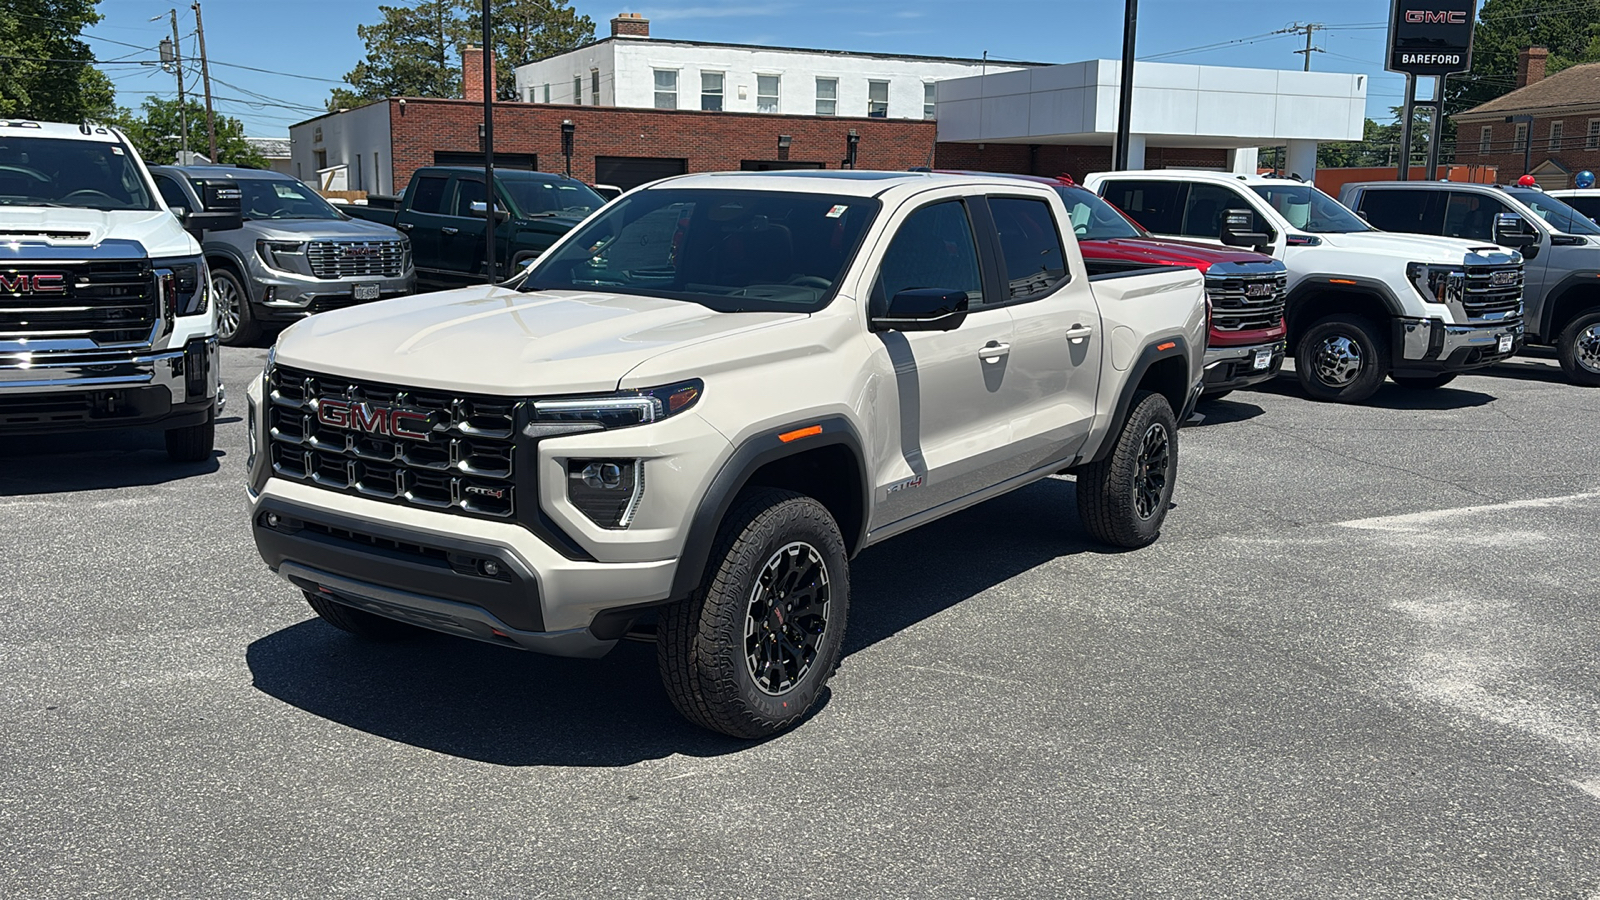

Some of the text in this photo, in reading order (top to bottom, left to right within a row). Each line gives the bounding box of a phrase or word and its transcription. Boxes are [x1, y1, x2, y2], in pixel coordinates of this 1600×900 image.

[1405, 10, 1466, 23] GMC
[1402, 54, 1460, 64] BAREFORD
[318, 398, 434, 441] GMC
[465, 486, 503, 498] AT4
